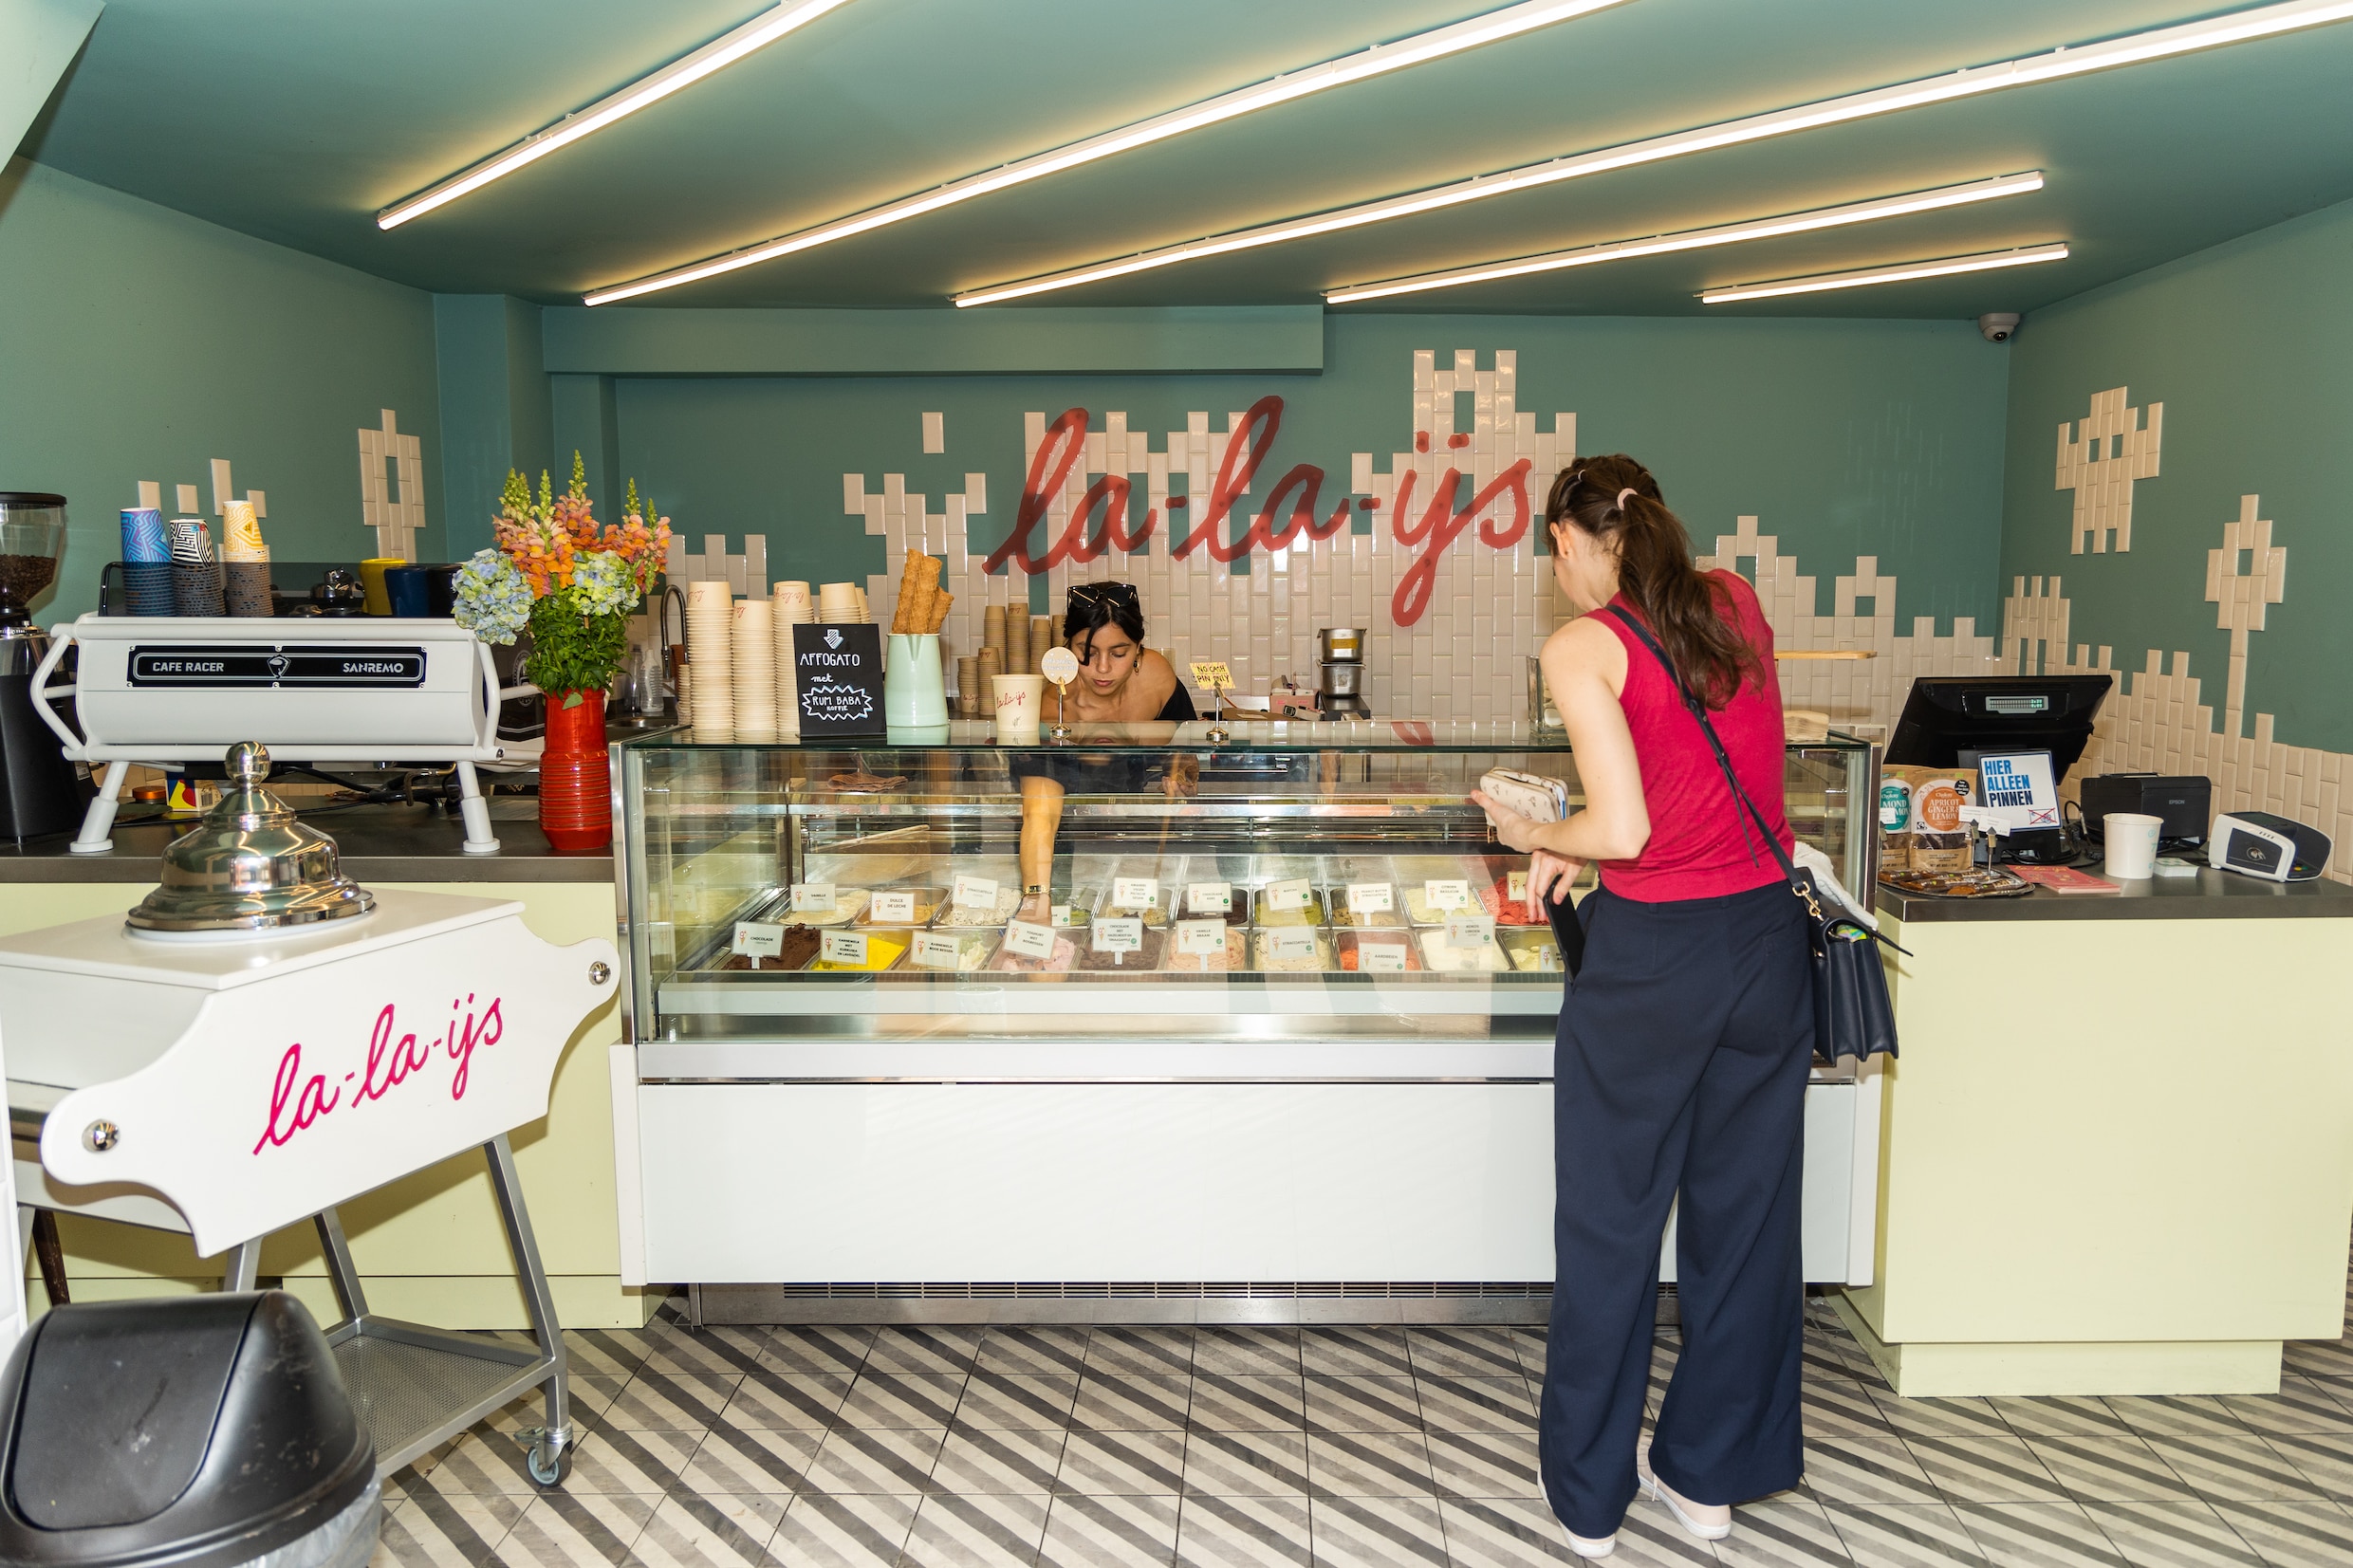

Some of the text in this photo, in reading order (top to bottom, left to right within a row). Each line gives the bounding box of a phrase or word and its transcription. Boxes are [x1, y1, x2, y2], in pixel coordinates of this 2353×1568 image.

[800, 653, 861, 666] AFFOGATO
[152, 662, 224, 672] CAFE RACER
[343, 663, 404, 673] SANREMO
[811, 673, 833, 682] met
[1196, 674, 1211, 683] PIN
[812, 696, 862, 706] RUM BABA
[1984, 759, 2012, 775] HIER
[1987, 775, 2030, 791] ALLEEN
[1882, 800, 1907, 808] MOND
[1989, 791, 2033, 807] PINNEN
